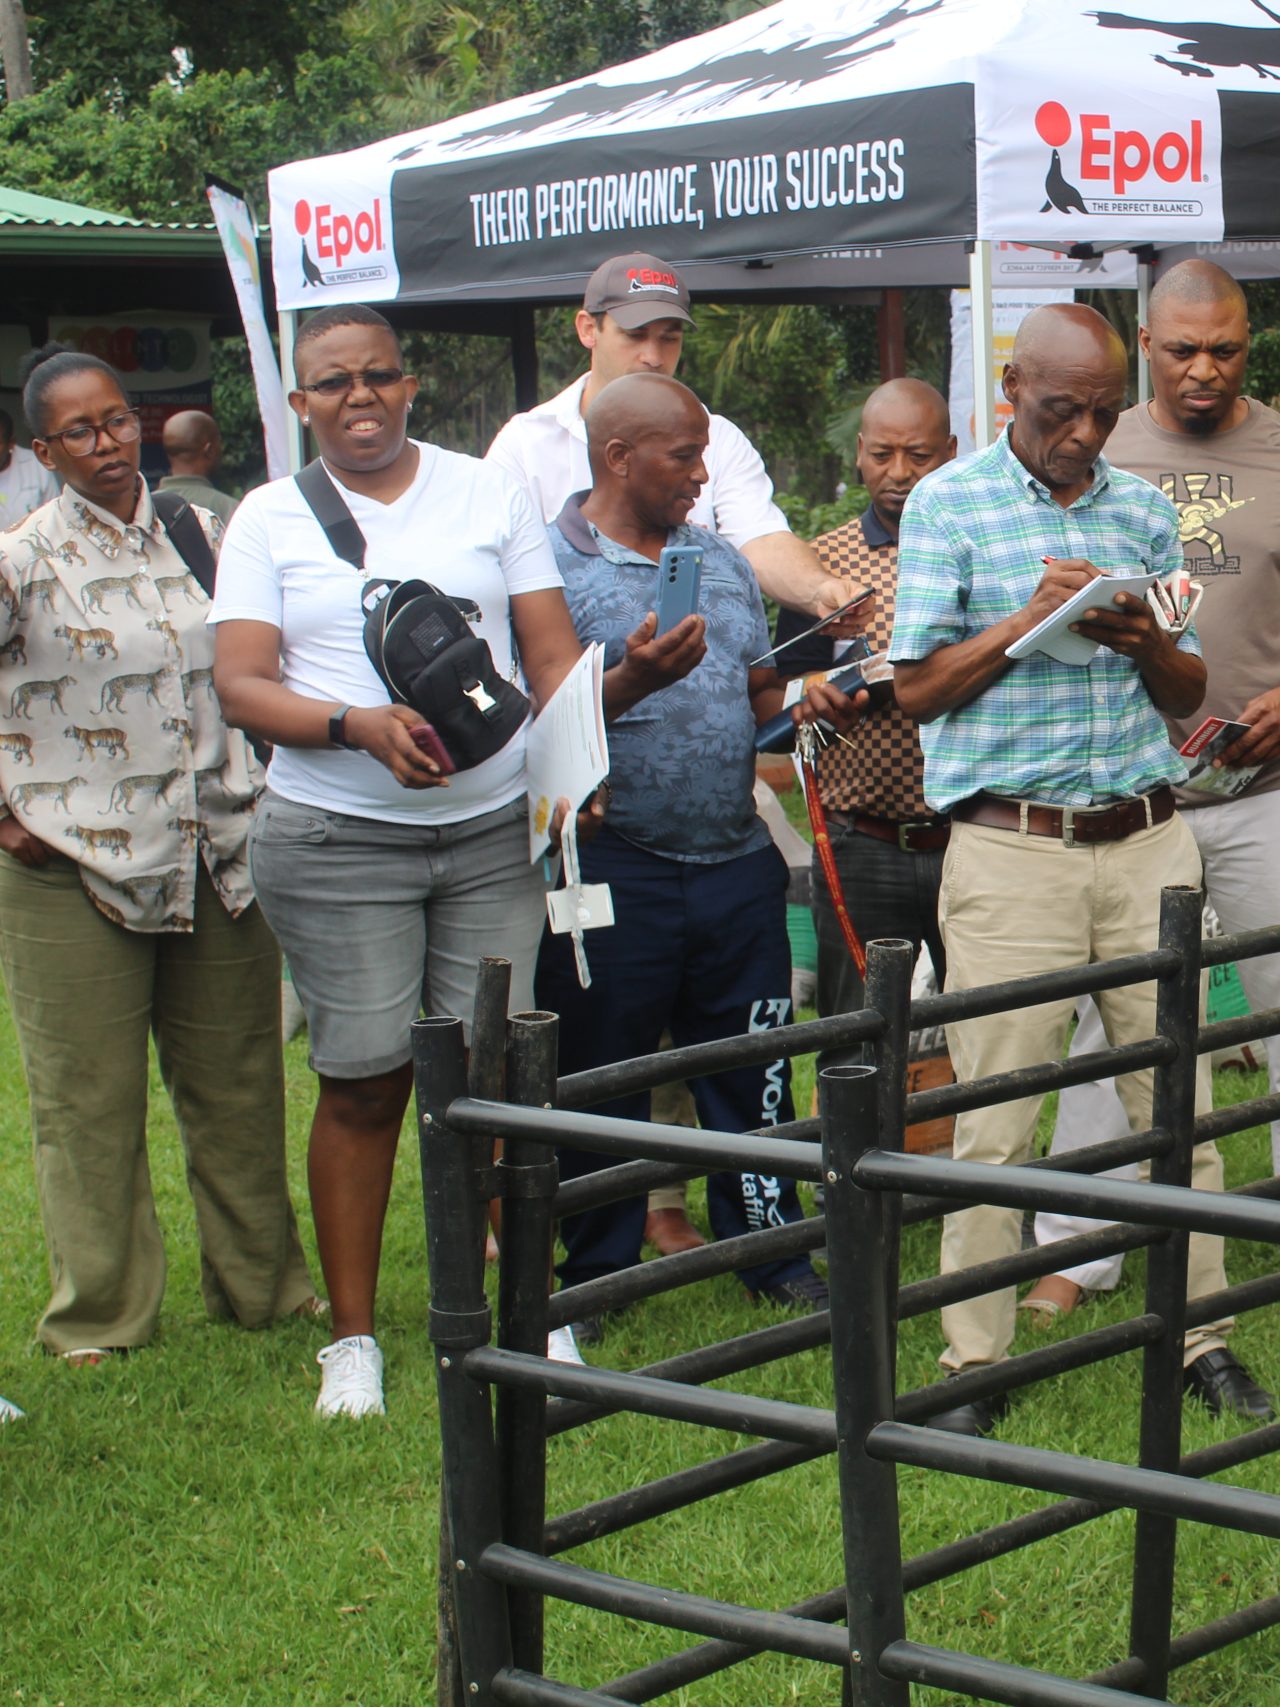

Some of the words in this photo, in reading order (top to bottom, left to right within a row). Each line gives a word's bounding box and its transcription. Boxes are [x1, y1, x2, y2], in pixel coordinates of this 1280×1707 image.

[1079, 113, 1203, 195] Epol
[469, 187, 531, 247] THEIR
[535, 164, 704, 239] PERFORMANCE,
[710, 153, 779, 219] YOUR
[785, 138, 905, 210] SUCCESS
[1092, 202, 1110, 212] THE
[1112, 202, 1150, 213] PERFECT
[1153, 203, 1194, 213] BALANCE
[315, 198, 383, 268] Epol
[639, 268, 676, 288] Epol
[740, 1171, 766, 1234] taffin
